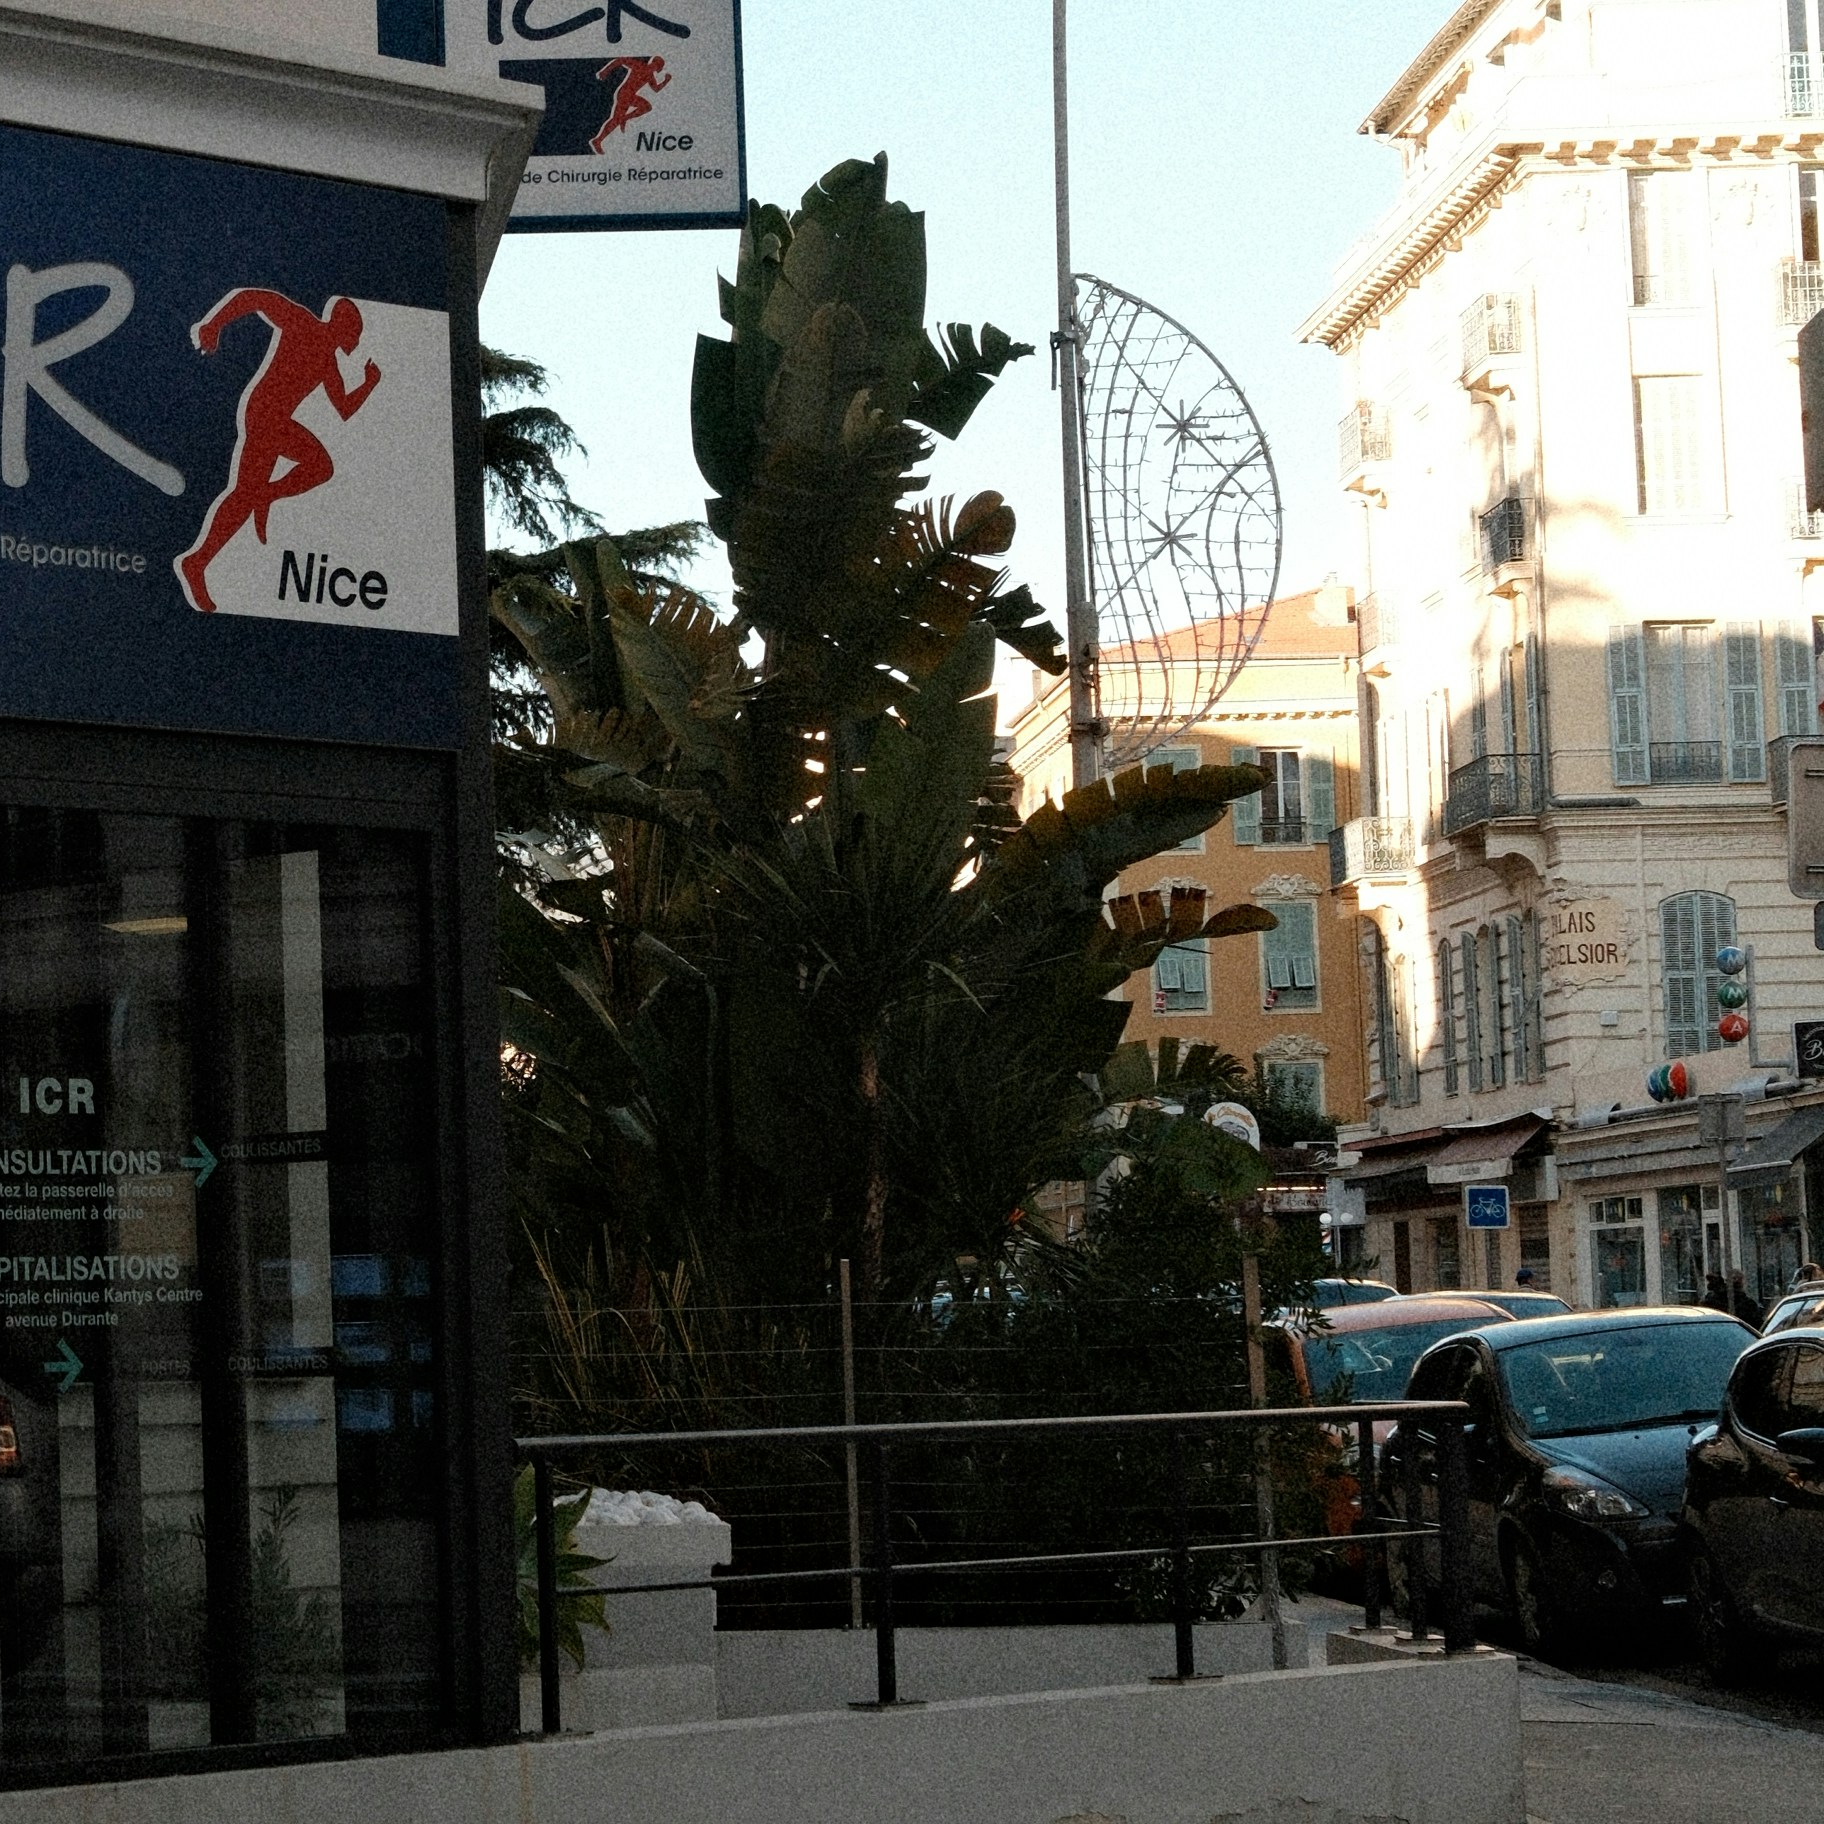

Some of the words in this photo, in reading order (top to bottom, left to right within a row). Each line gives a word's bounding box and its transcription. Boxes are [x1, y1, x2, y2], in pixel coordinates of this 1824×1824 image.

[636, 131, 694, 152] Nice
[521, 171, 542, 185] de
[547, 168, 622, 185] Chirurgie
[627, 165, 724, 184] Réparatrice
[0, 533, 148, 575] Réparatrice
[277, 549, 390, 610] Nice
[18, 1077, 96, 1115] ICR
[24, 1182, 38, 1197] la
[41, 1182, 115, 1199] passerelle
[90, 1204, 99, 1220] à
[102, 1204, 144, 1220] droite
[43, 1288, 100, 1306] clinique
[103, 1287, 153, 1307] Kantys
[156, 1286, 204, 1303] Centre
[4, 1312, 58, 1328] avenue
[62, 1310, 119, 1328] Durante
